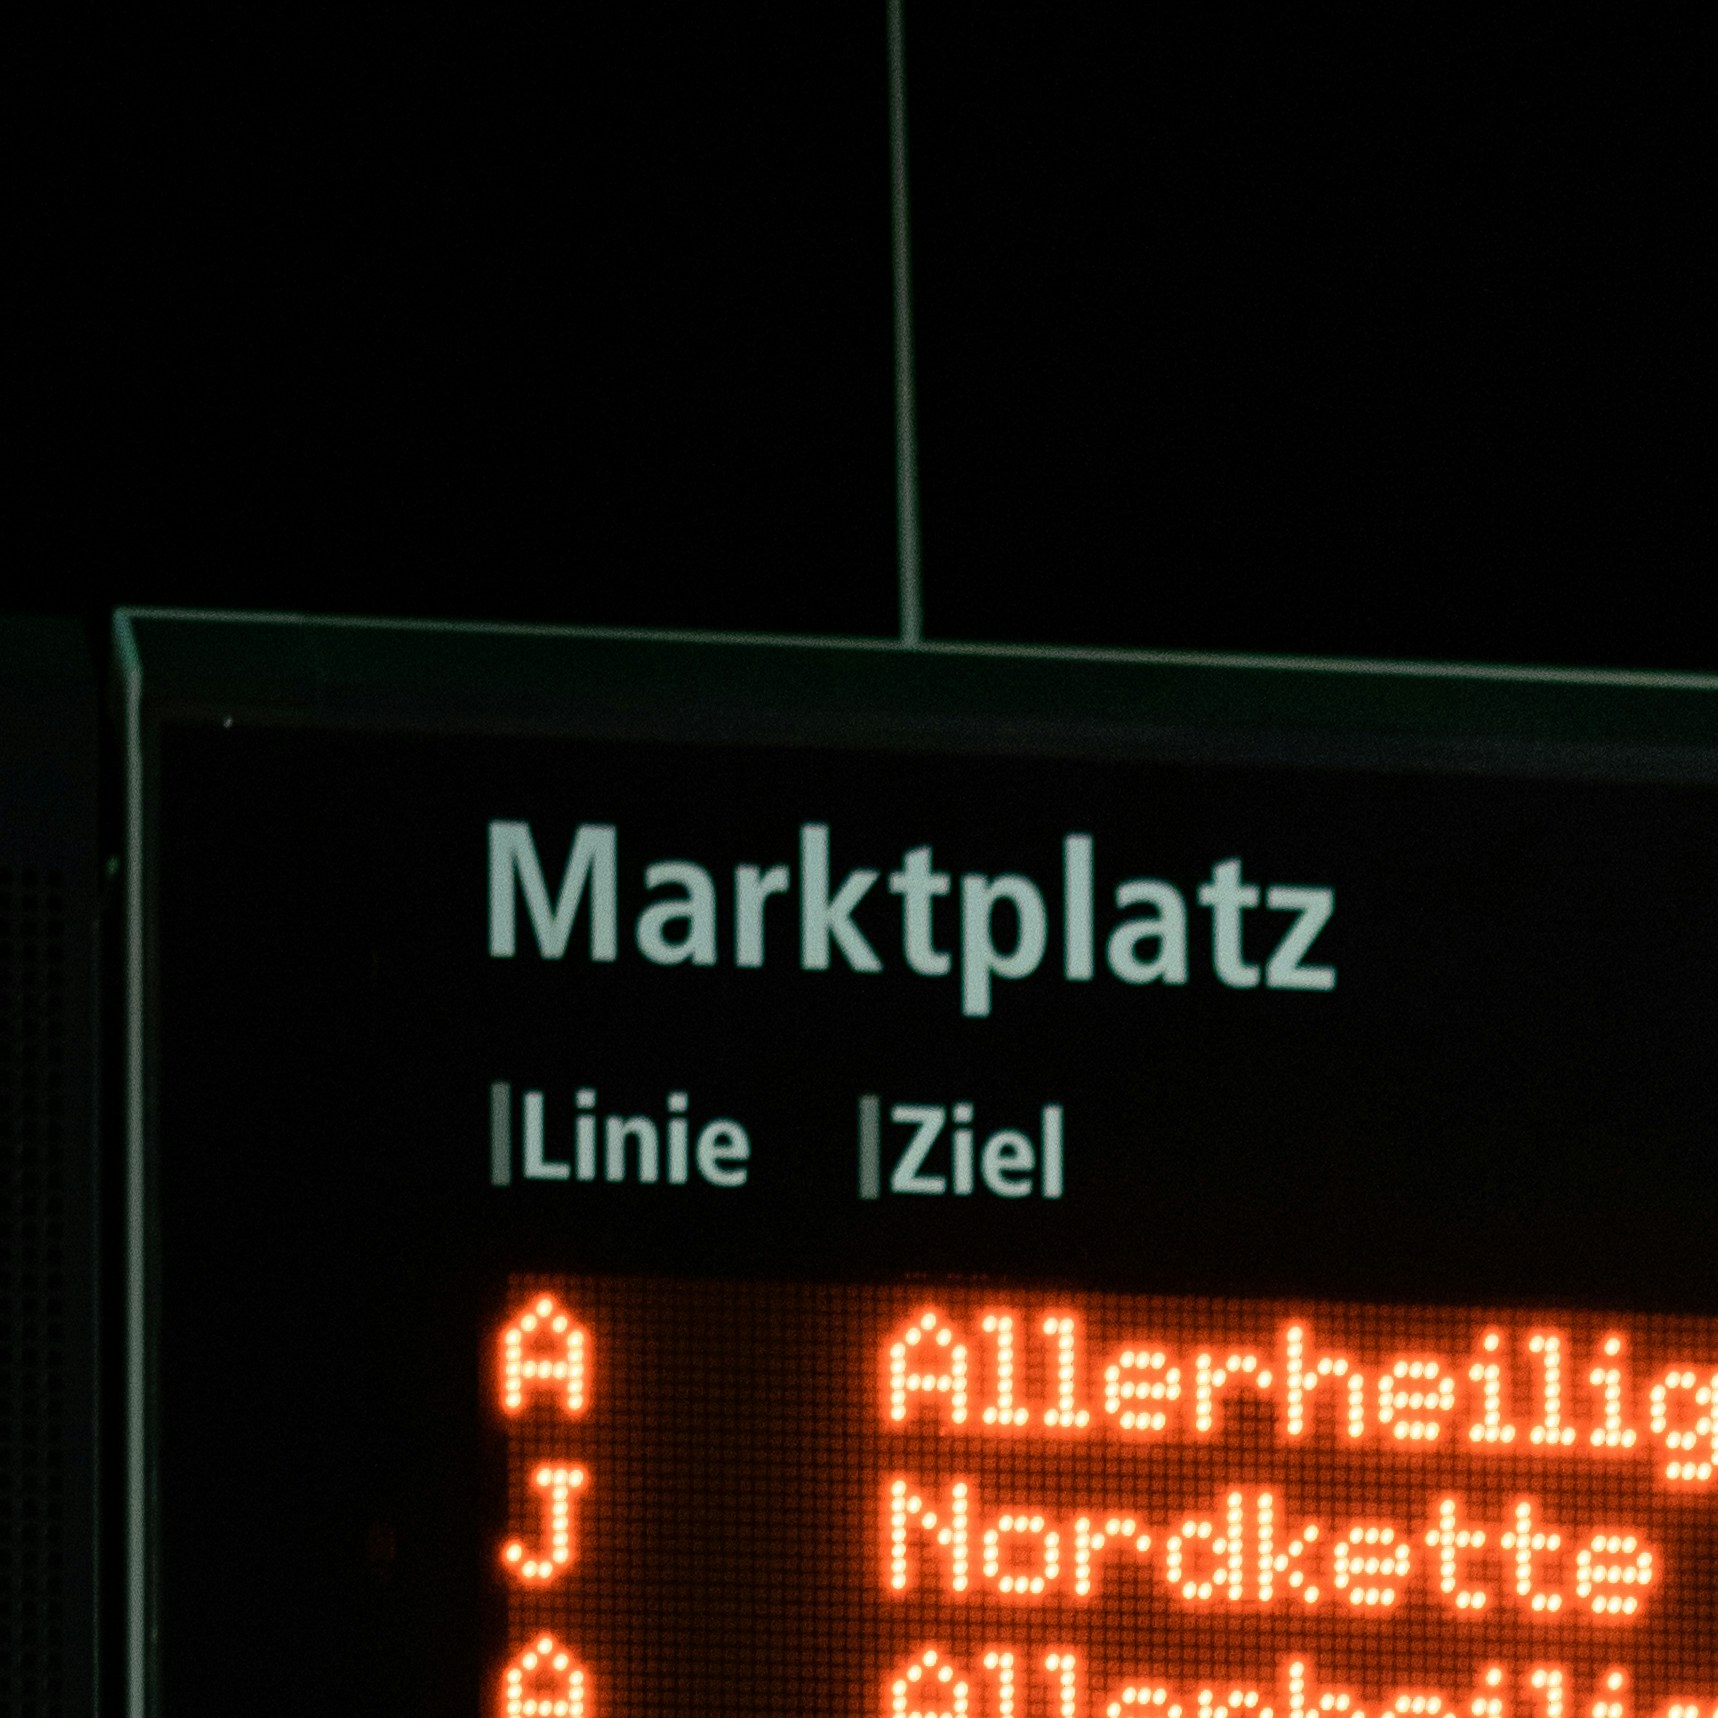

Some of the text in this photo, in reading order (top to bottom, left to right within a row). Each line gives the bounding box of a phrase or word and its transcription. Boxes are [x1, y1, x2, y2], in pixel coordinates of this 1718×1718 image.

[488, 821, 1336, 1016] Marktplatz
[522, 1088, 750, 1187] Linie
[890, 1102, 1064, 1199] Ziel
[502, 1293, 590, 1413] A
[502, 1463, 588, 1583] J
[886, 1478, 1658, 1616] Nordkette
